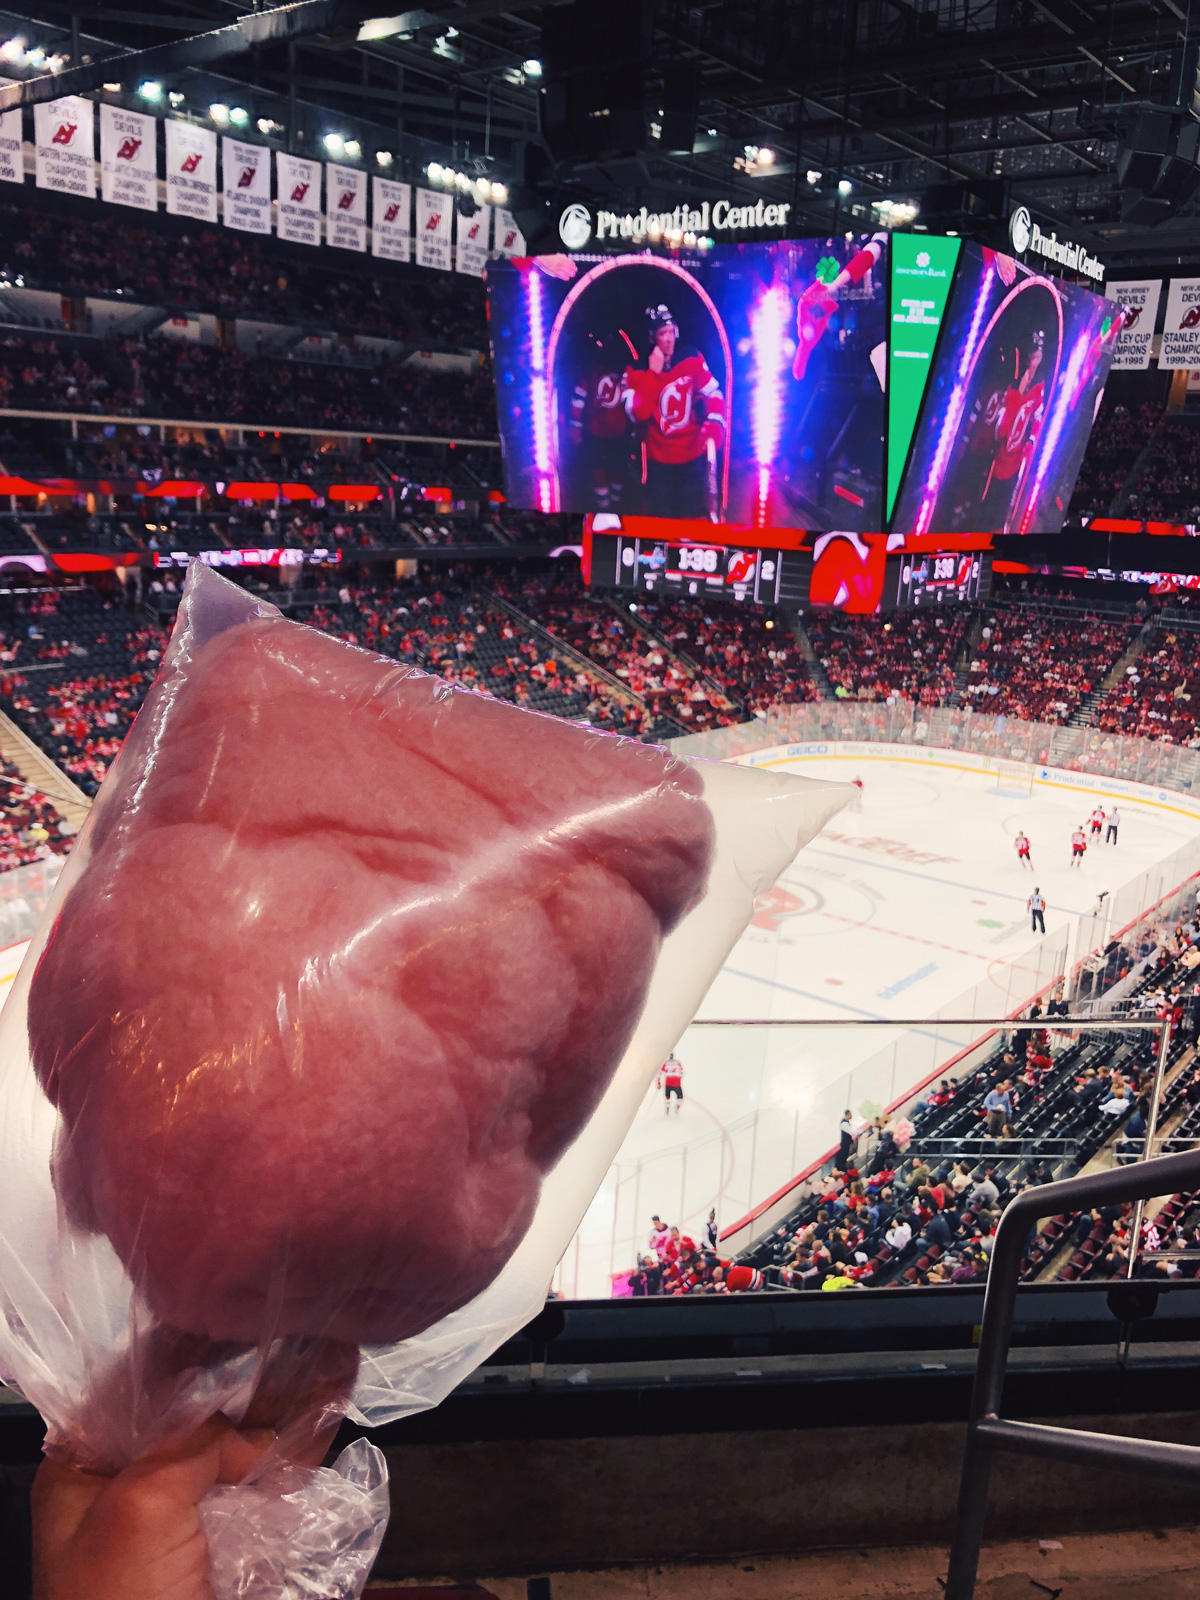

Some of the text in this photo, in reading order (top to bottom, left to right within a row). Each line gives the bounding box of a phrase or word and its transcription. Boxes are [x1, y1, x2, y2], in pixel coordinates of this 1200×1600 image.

[114, 121, 143, 136] DEVILS
[596, 198, 791, 238] Prudential Center
[1030, 223, 1106, 282] Prudential Center
[1117, 295, 1146, 304] DEVILS
[1182, 293, 1200, 302] DEVI
[1134, 333, 1151, 342] CUP
[1163, 332, 1200, 343] STANLEY
[1114, 345, 1147, 355] MPIONS
[1164, 344, 1200, 355] CHAMPIO
[622, 547, 635, 567] 0
[678, 547, 718, 573] 1:38
[761, 560, 775, 581] 2
[972, 561, 979, 579] 2
[787, 745, 828, 756] GEICO
[1054, 772, 1094, 787] Prudential
[1100, 781, 1129, 791] Walmart
